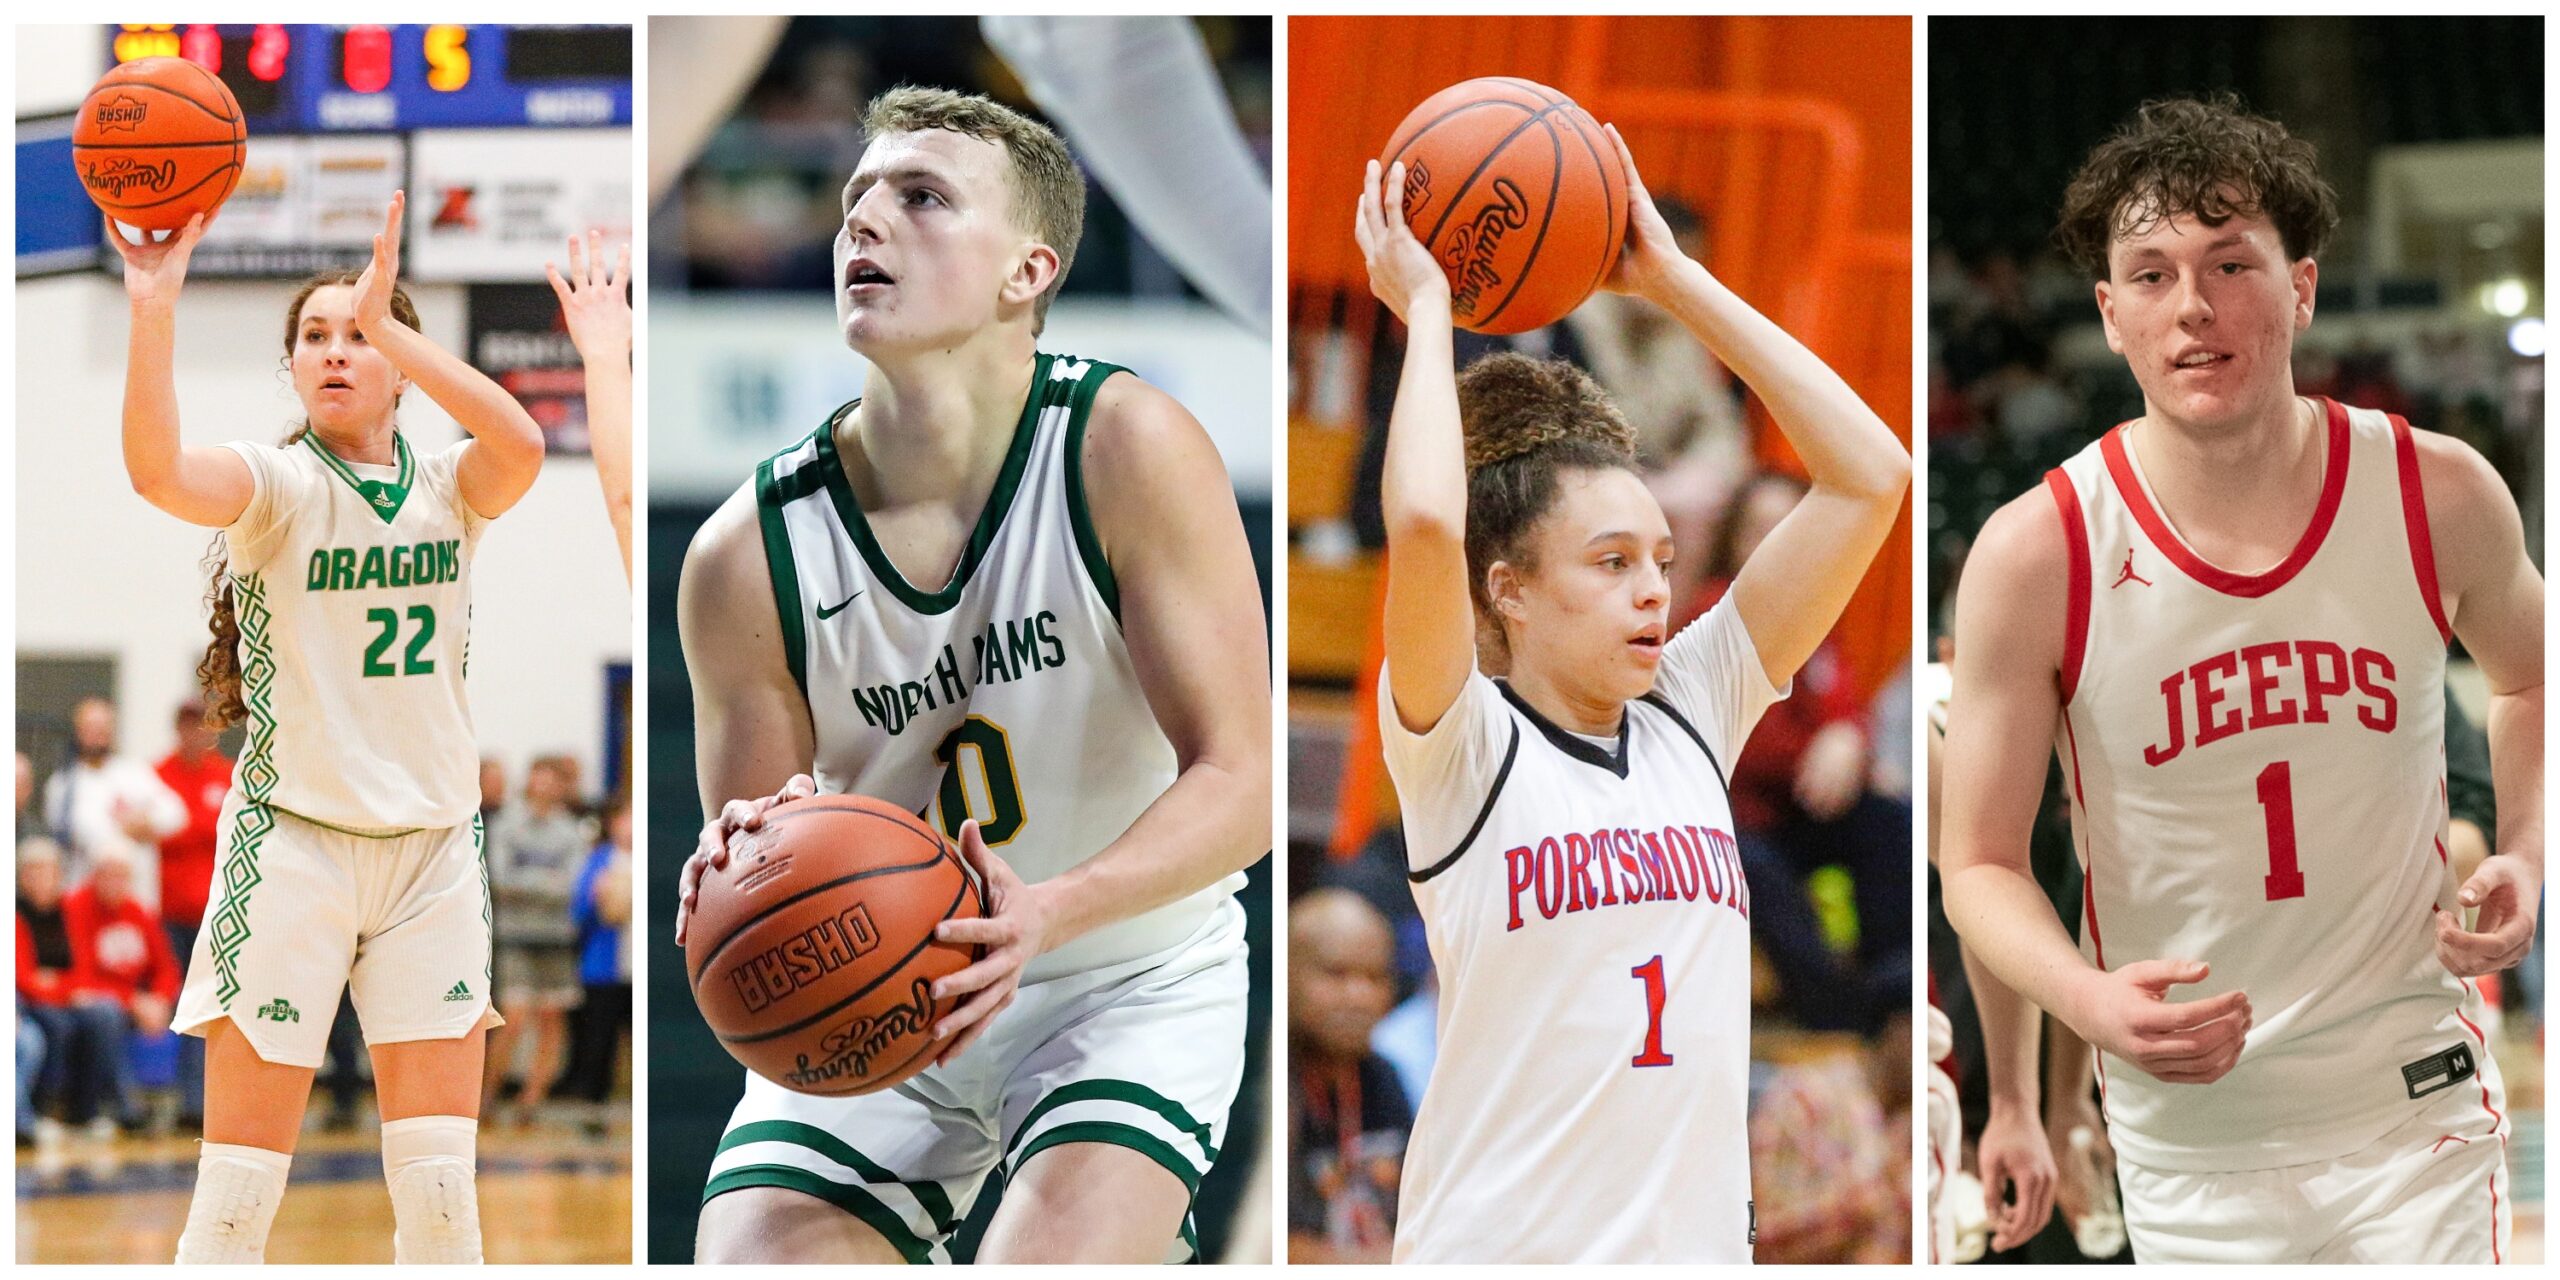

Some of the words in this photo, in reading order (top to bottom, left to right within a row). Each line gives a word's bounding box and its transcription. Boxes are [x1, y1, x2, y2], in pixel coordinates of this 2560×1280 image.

[83, 159, 176, 198] Rawlings
[1402, 167, 1427, 212] OHS
[306, 540, 460, 592] DRAGONS
[363, 604, 436, 677] 22
[2143, 640, 2398, 767] JEEPS
[2256, 760, 2305, 901] 1
[728, 902, 881, 1014] OHSAA
[785, 977, 936, 1087] Rawlings
[1631, 955, 1673, 1067] 1
[2452, 1055, 2467, 1072] M
